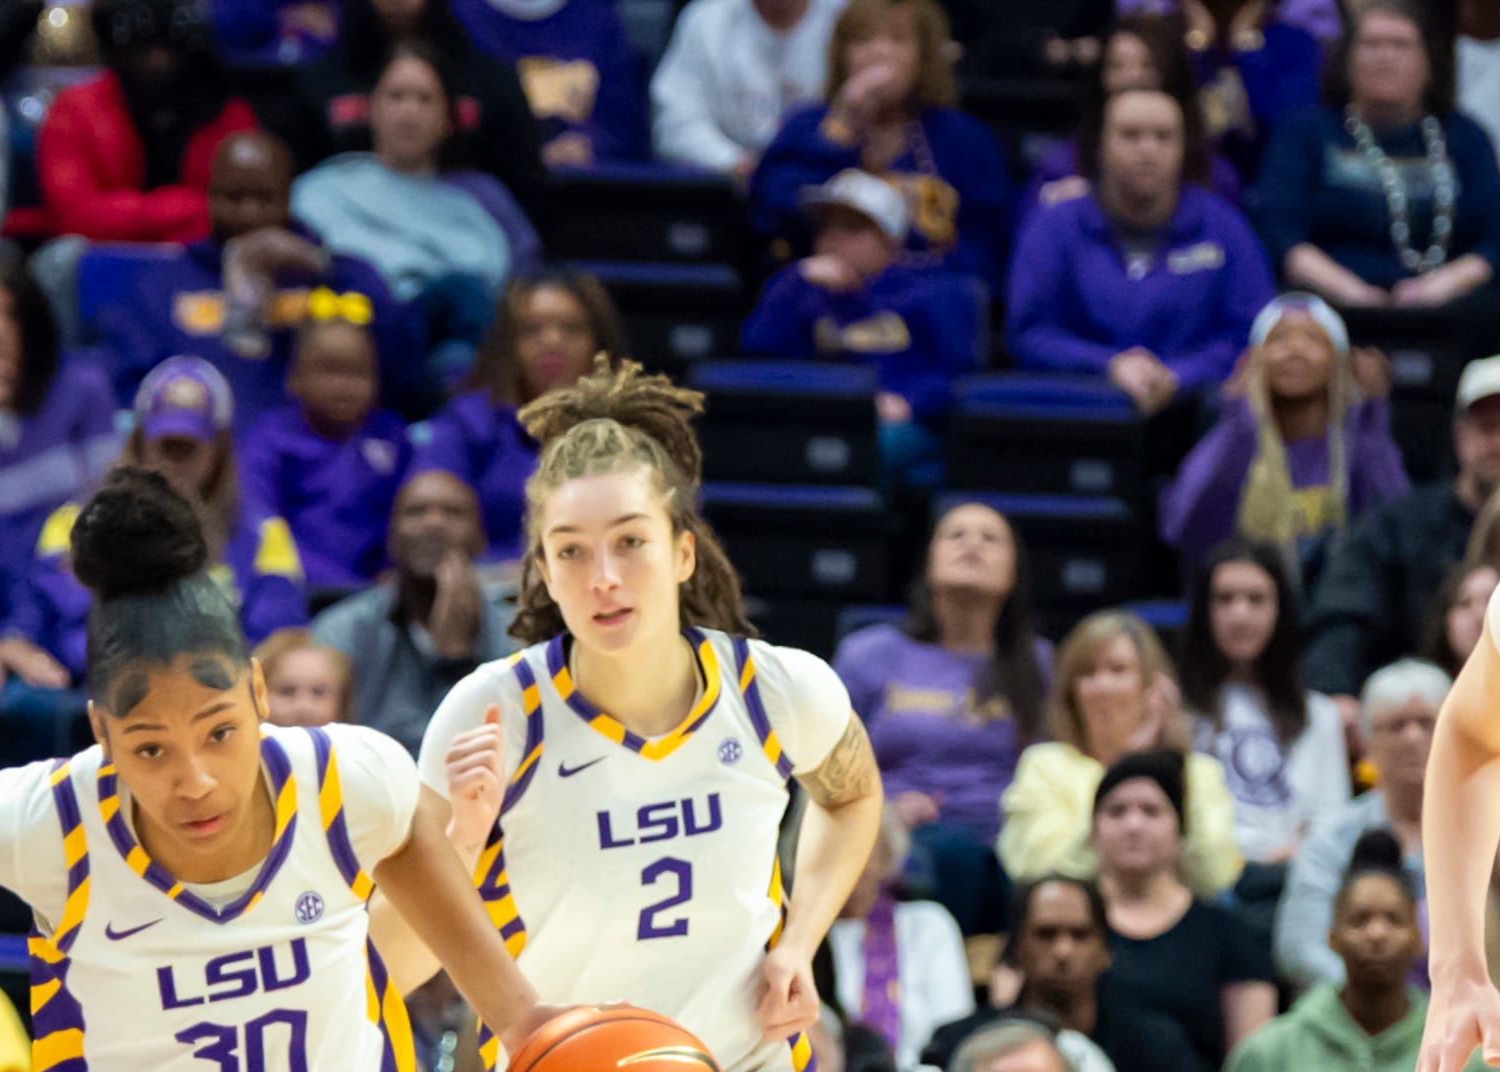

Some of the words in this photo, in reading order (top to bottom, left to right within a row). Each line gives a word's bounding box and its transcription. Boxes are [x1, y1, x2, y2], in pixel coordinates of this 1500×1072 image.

[596, 791, 722, 850] LSU
[296, 892, 323, 923] SEC
[637, 855, 692, 941] 2
[156, 936, 311, 1011] LSU
